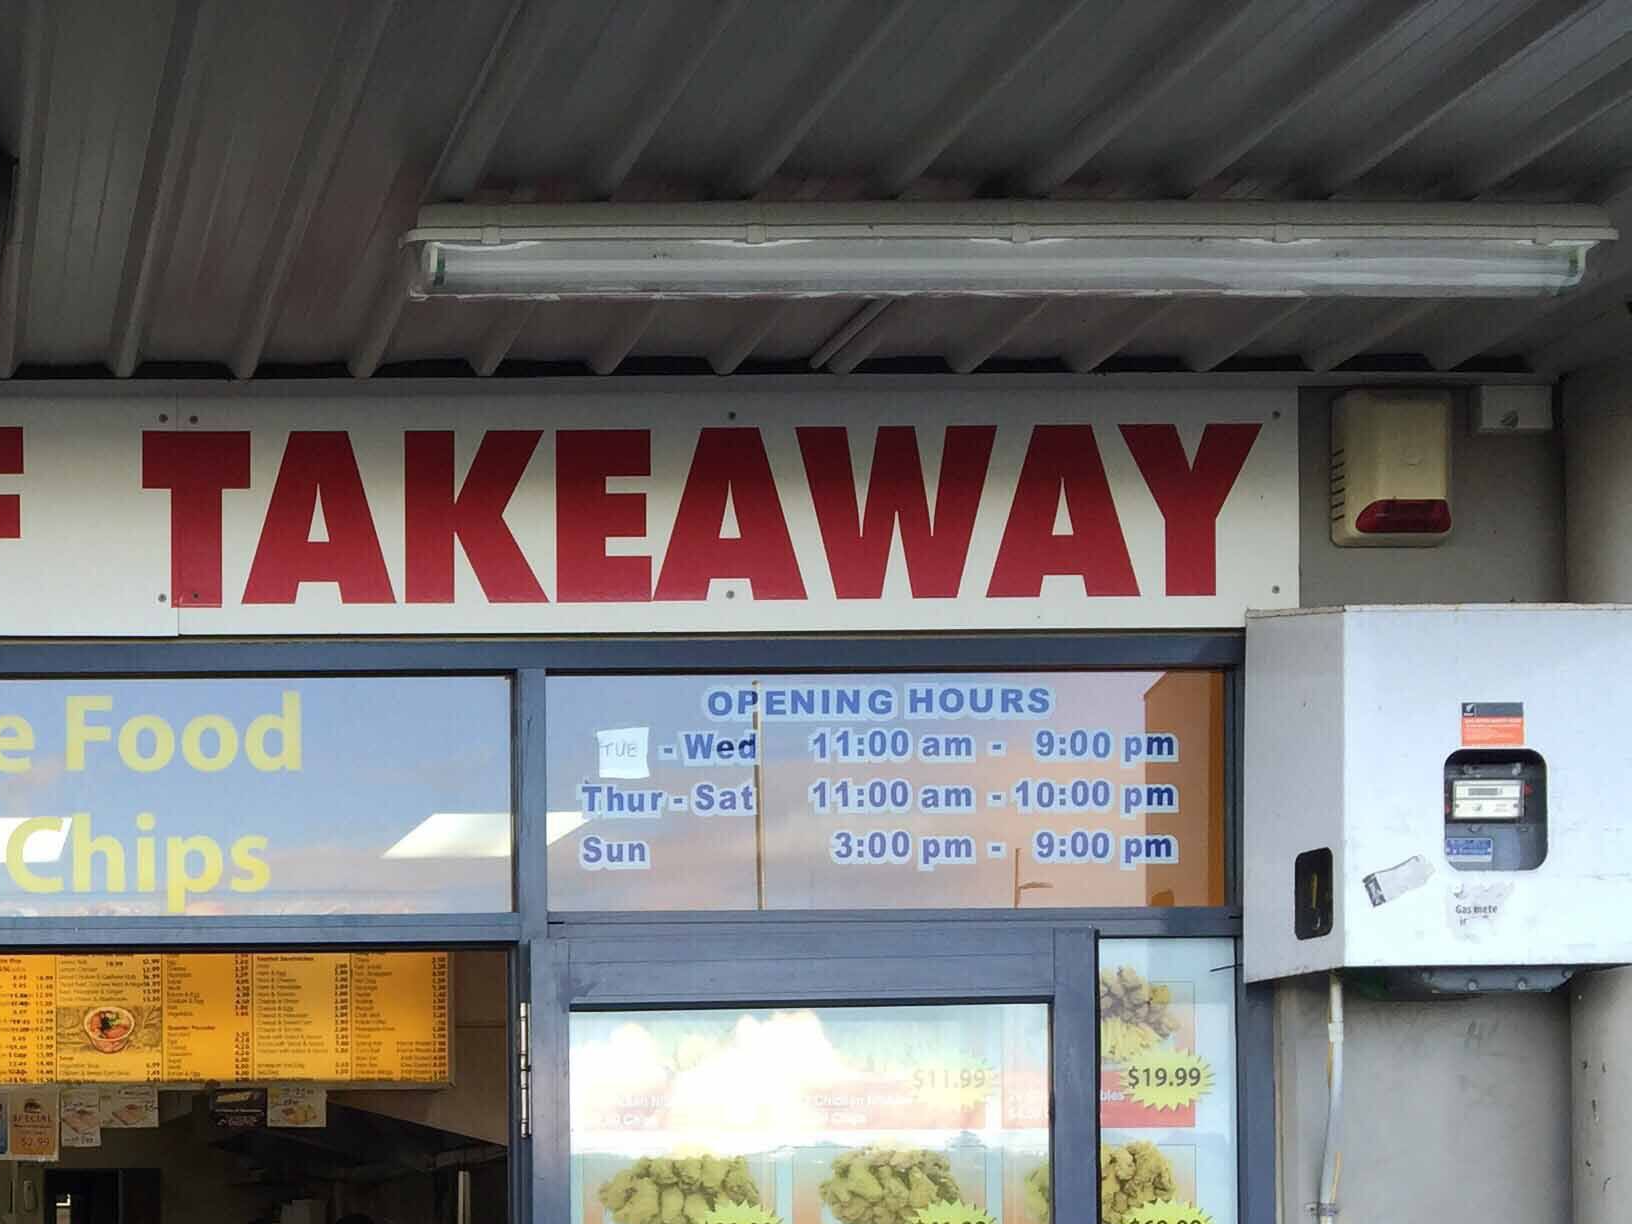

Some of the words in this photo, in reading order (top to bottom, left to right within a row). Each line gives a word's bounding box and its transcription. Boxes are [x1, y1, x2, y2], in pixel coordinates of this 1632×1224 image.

[142, 423, 1261, 608] TAKEAWAY
[708, 689, 893, 716] OPENING
[909, 688, 1050, 714] HOURS
[67, 691, 301, 774] Food
[685, 733, 756, 760] Wed
[812, 731, 909, 758] 11:00
[922, 737, 971, 758] am
[1036, 731, 1110, 758] 9:00
[1124, 737, 1175, 763] pm
[602, 741, 639, 760] TUE
[583, 786, 663, 812] Thur
[695, 784, 754, 811] Sat
[812, 782, 909, 808] 11:00
[922, 788, 971, 808] am
[1015, 781, 1110, 808] 10:00
[1124, 787, 1175, 813] pm
[5, 814, 269, 912] Chips
[583, 837, 646, 863] Sun
[834, 832, 909, 858] 3:00
[922, 838, 972, 864] pm
[1036, 832, 1110, 858] 9:00
[1124, 838, 1174, 863] pm
[913, 1068, 986, 1091] $11.99
[1128, 1067, 1200, 1088] $19.99
